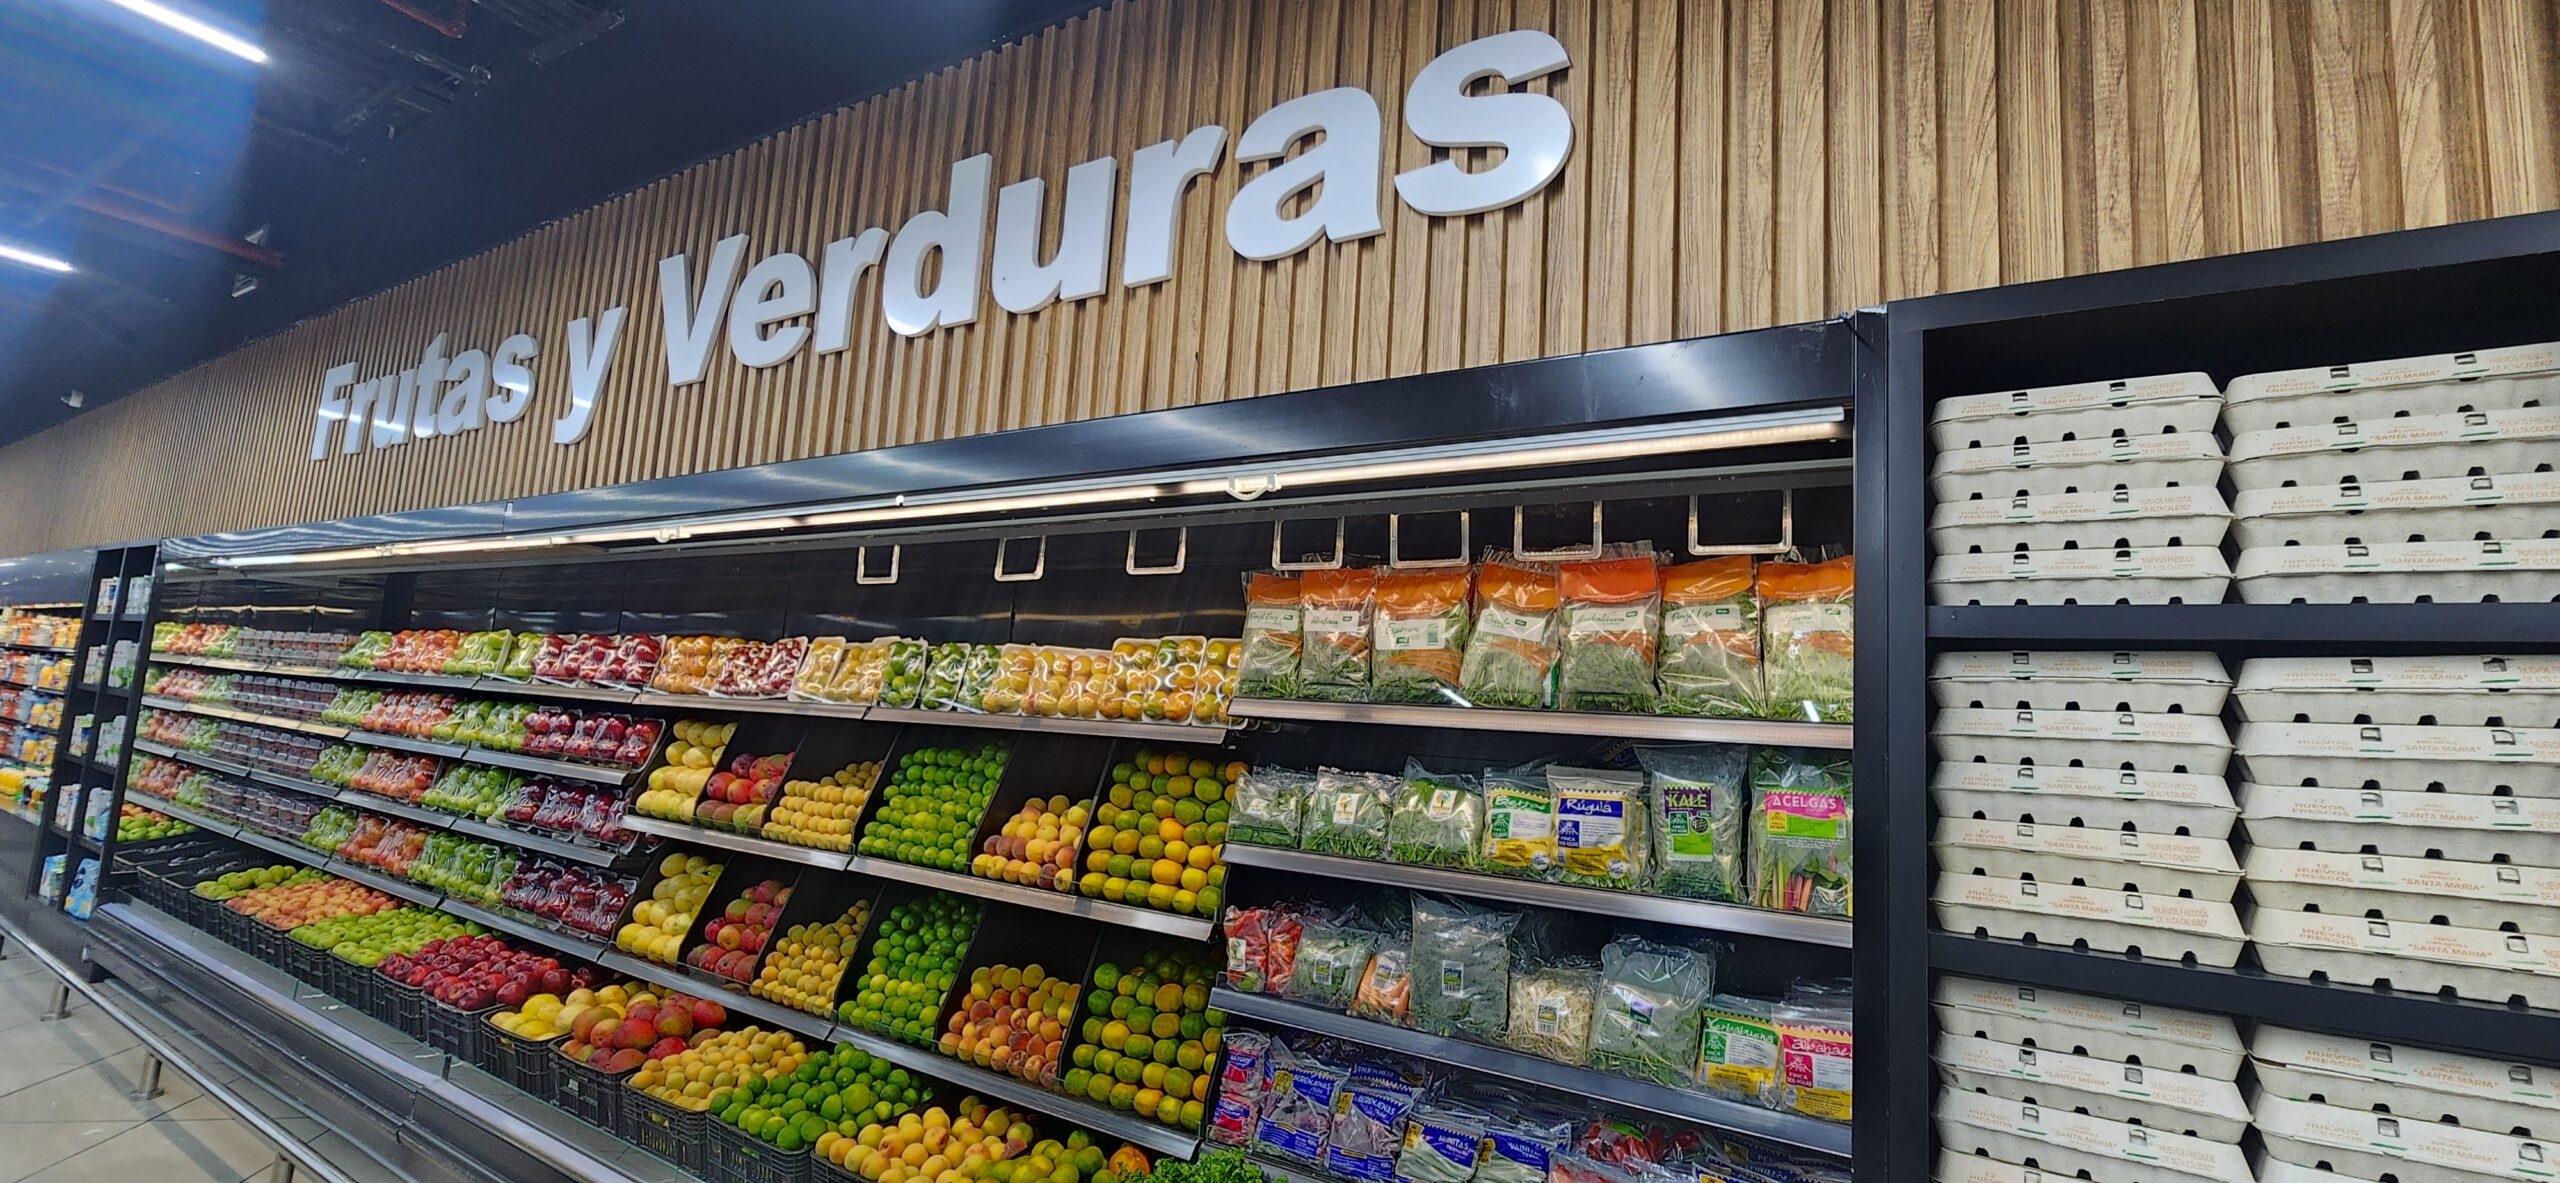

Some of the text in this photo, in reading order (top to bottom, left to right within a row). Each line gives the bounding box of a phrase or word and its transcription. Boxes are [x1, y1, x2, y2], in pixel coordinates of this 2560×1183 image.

[312, 28, 1574, 461] Frutas y Verduras
[1496, 795, 1546, 810] Berros
[1668, 794, 1707, 808] KALE
[1772, 796, 1836, 810] ACELGAS
[1706, 1018, 1774, 1042] Yerbabuena
[1789, 1072, 1808, 1080] FINCA
[1358, 1095, 1396, 1115] BERENJENAS
